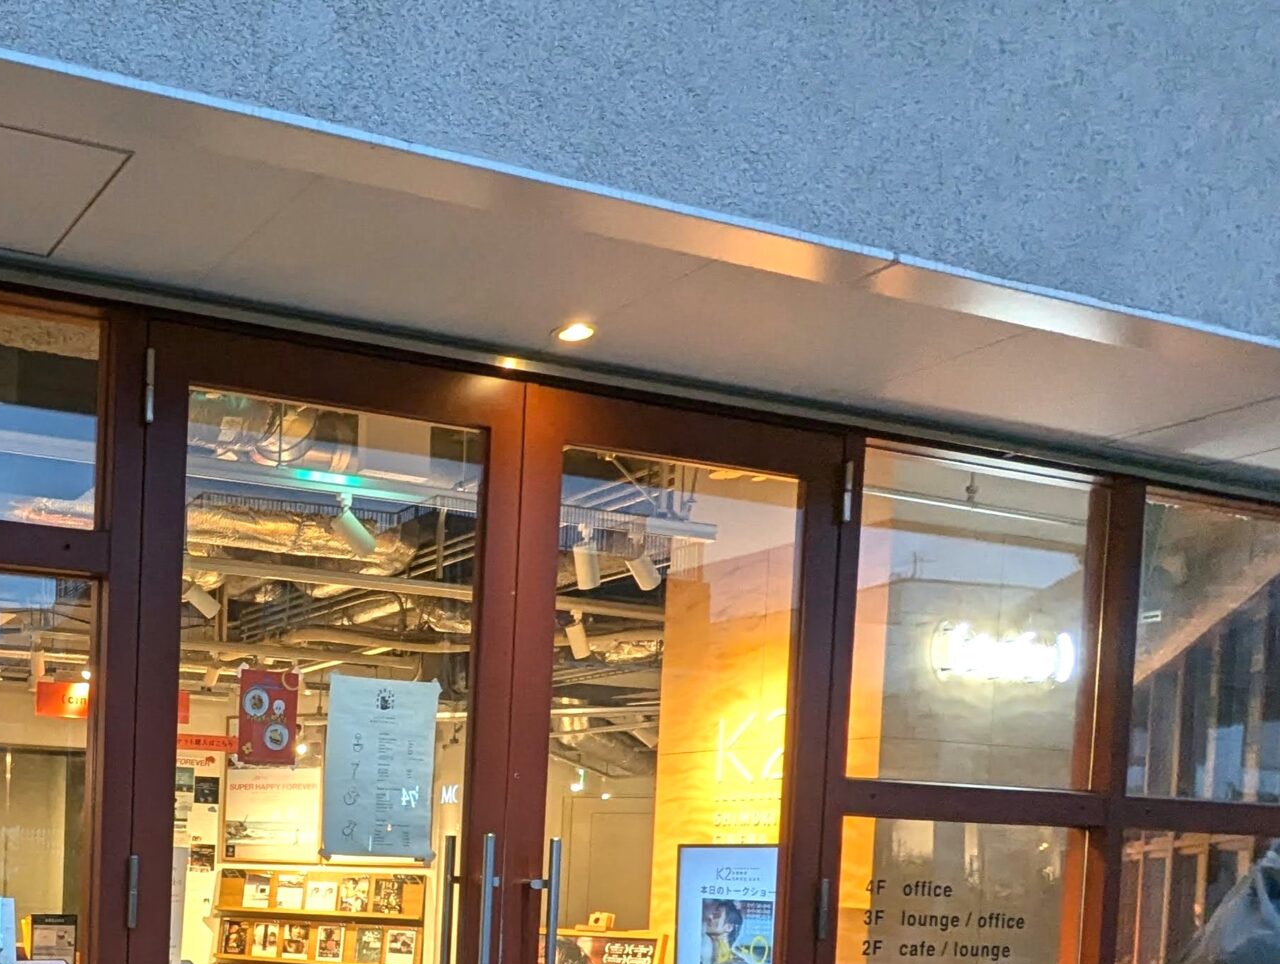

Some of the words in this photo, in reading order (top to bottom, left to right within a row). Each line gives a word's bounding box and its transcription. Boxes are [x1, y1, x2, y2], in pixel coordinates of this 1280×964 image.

[230, 783, 254, 791] SUPER
[255, 783, 280, 791] HAPPY
[716, 867, 732, 881] K2
[865, 879, 887, 895] 4F
[903, 880, 953, 898] office
[863, 909, 885, 926] 3F
[901, 910, 960, 931] lounge
[977, 913, 1025, 929] office
[861, 939, 883, 956] 2F
[899, 941, 935, 957] cafe
[954, 941, 1010, 961] lounge
